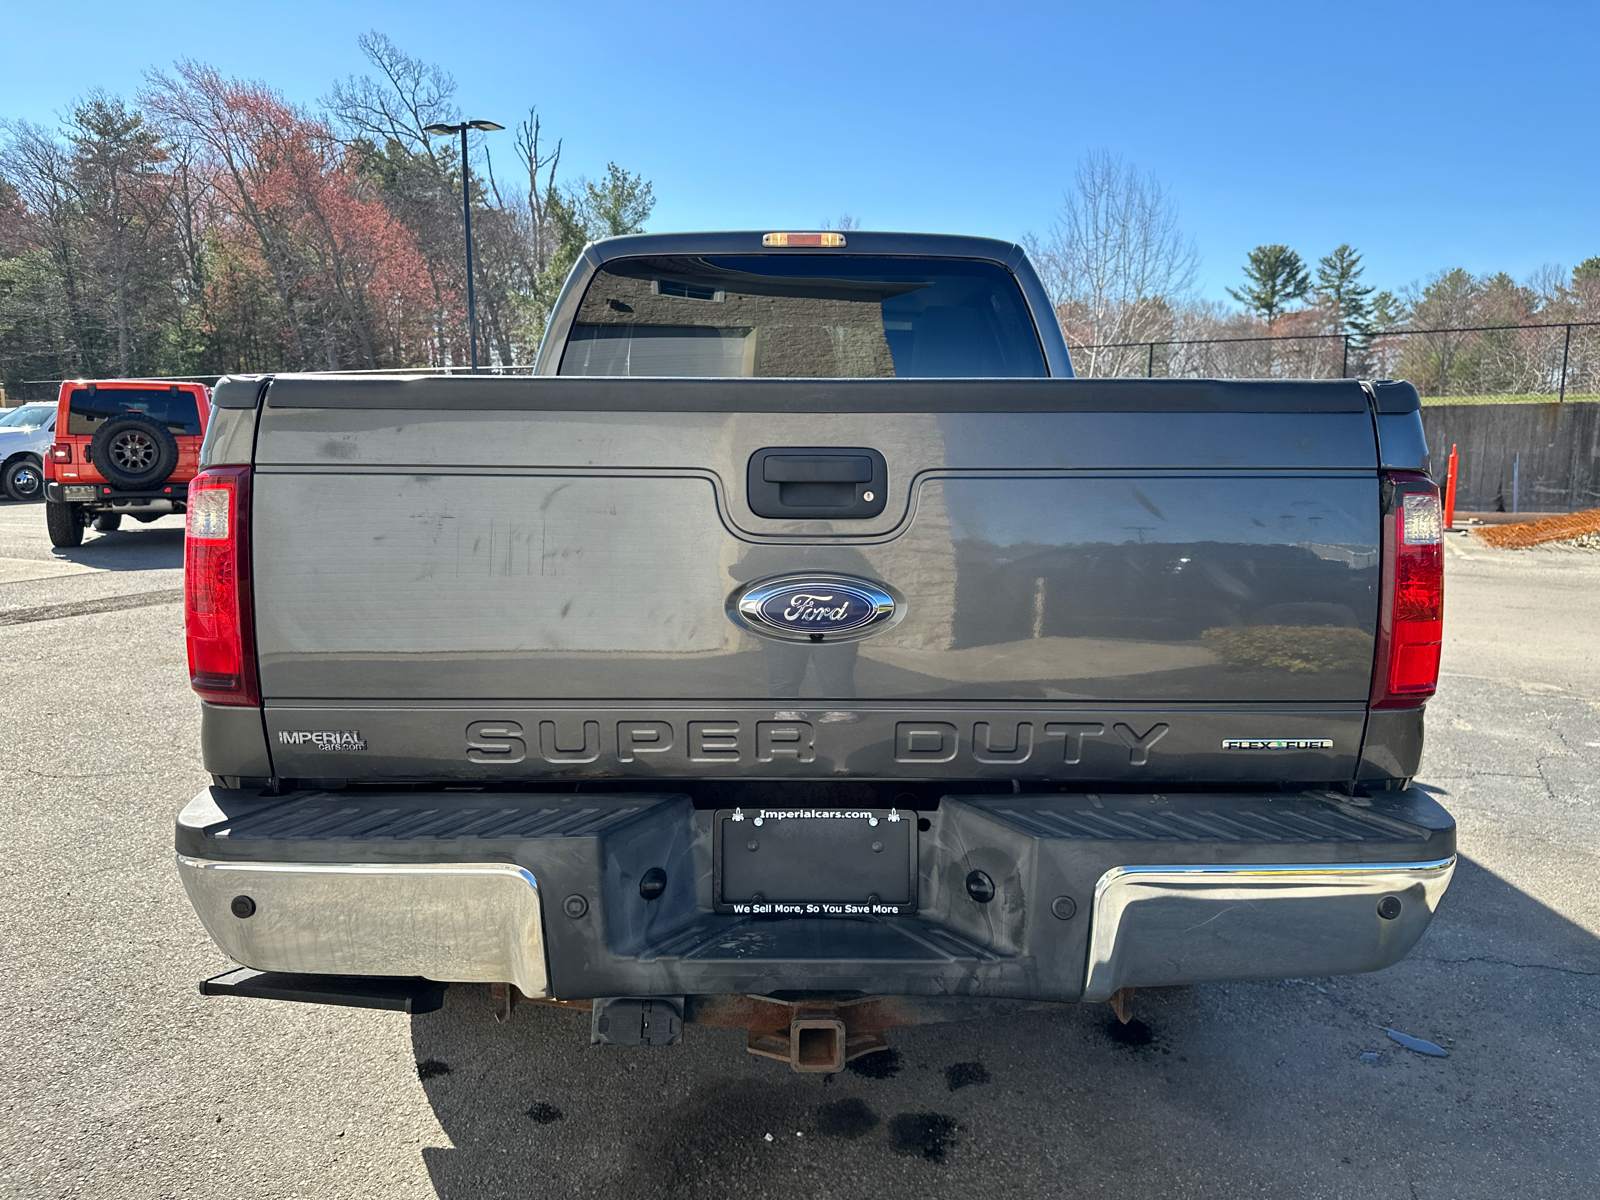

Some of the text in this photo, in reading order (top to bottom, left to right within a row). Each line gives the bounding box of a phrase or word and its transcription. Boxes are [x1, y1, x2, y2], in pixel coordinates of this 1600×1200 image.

[784, 594, 849, 621] Ford
[279, 730, 365, 745] IMPERIAL
[465, 720, 1169, 765] SUPER DUTY
[318, 743, 366, 751] cars.com
[1228, 741, 1331, 750] FLEX FUEL
[760, 809, 872, 820] Imperialcars.com
[733, 904, 899, 915] We Sell More, So You Save More
